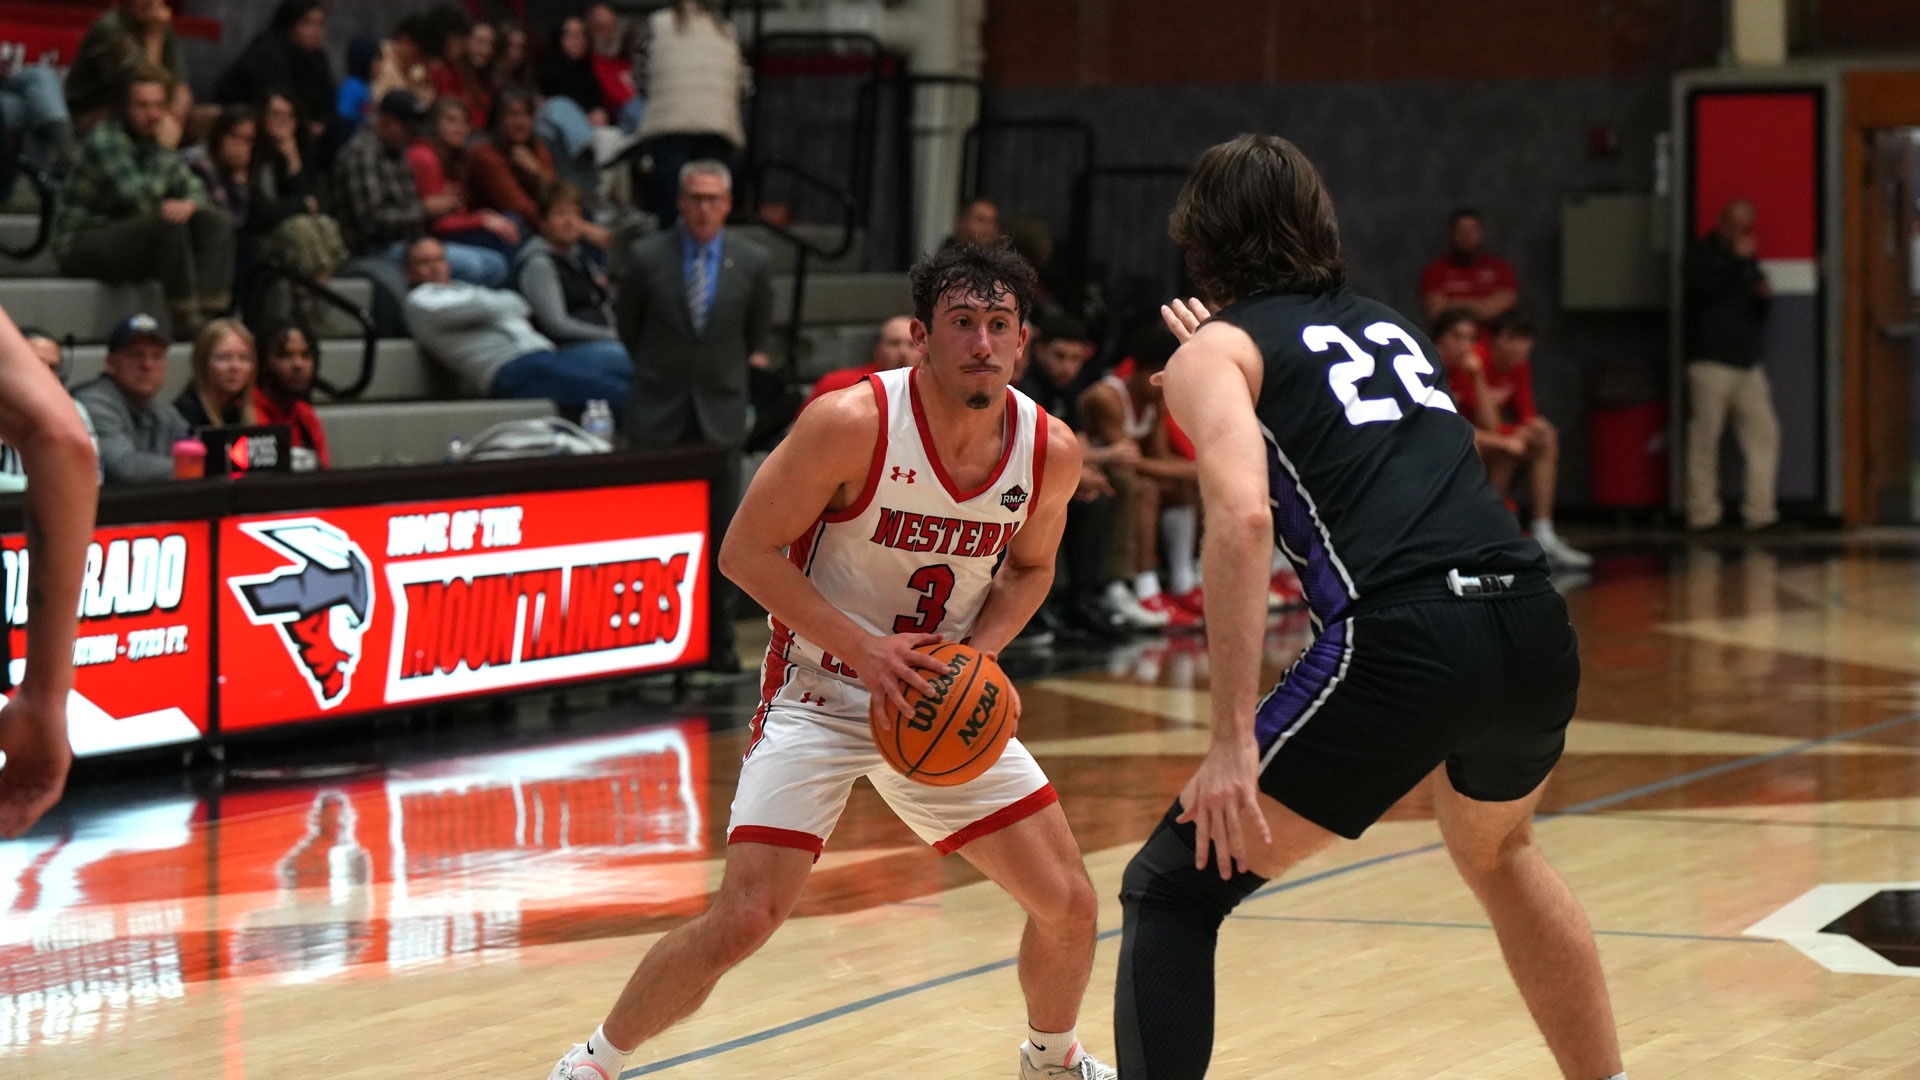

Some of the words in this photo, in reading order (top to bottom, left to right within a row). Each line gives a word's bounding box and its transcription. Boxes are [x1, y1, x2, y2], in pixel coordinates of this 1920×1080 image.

[1302, 321, 1457, 426] 22
[387, 513, 449, 557] HOME
[450, 510, 479, 551] OF
[481, 505, 523, 548] THE
[869, 507, 1021, 557] WESTERN
[399, 552, 690, 680] MOUNTAINEERS
[893, 563, 955, 636] 3
[908, 653, 972, 732] Wilson
[957, 679, 999, 747] NCAA
